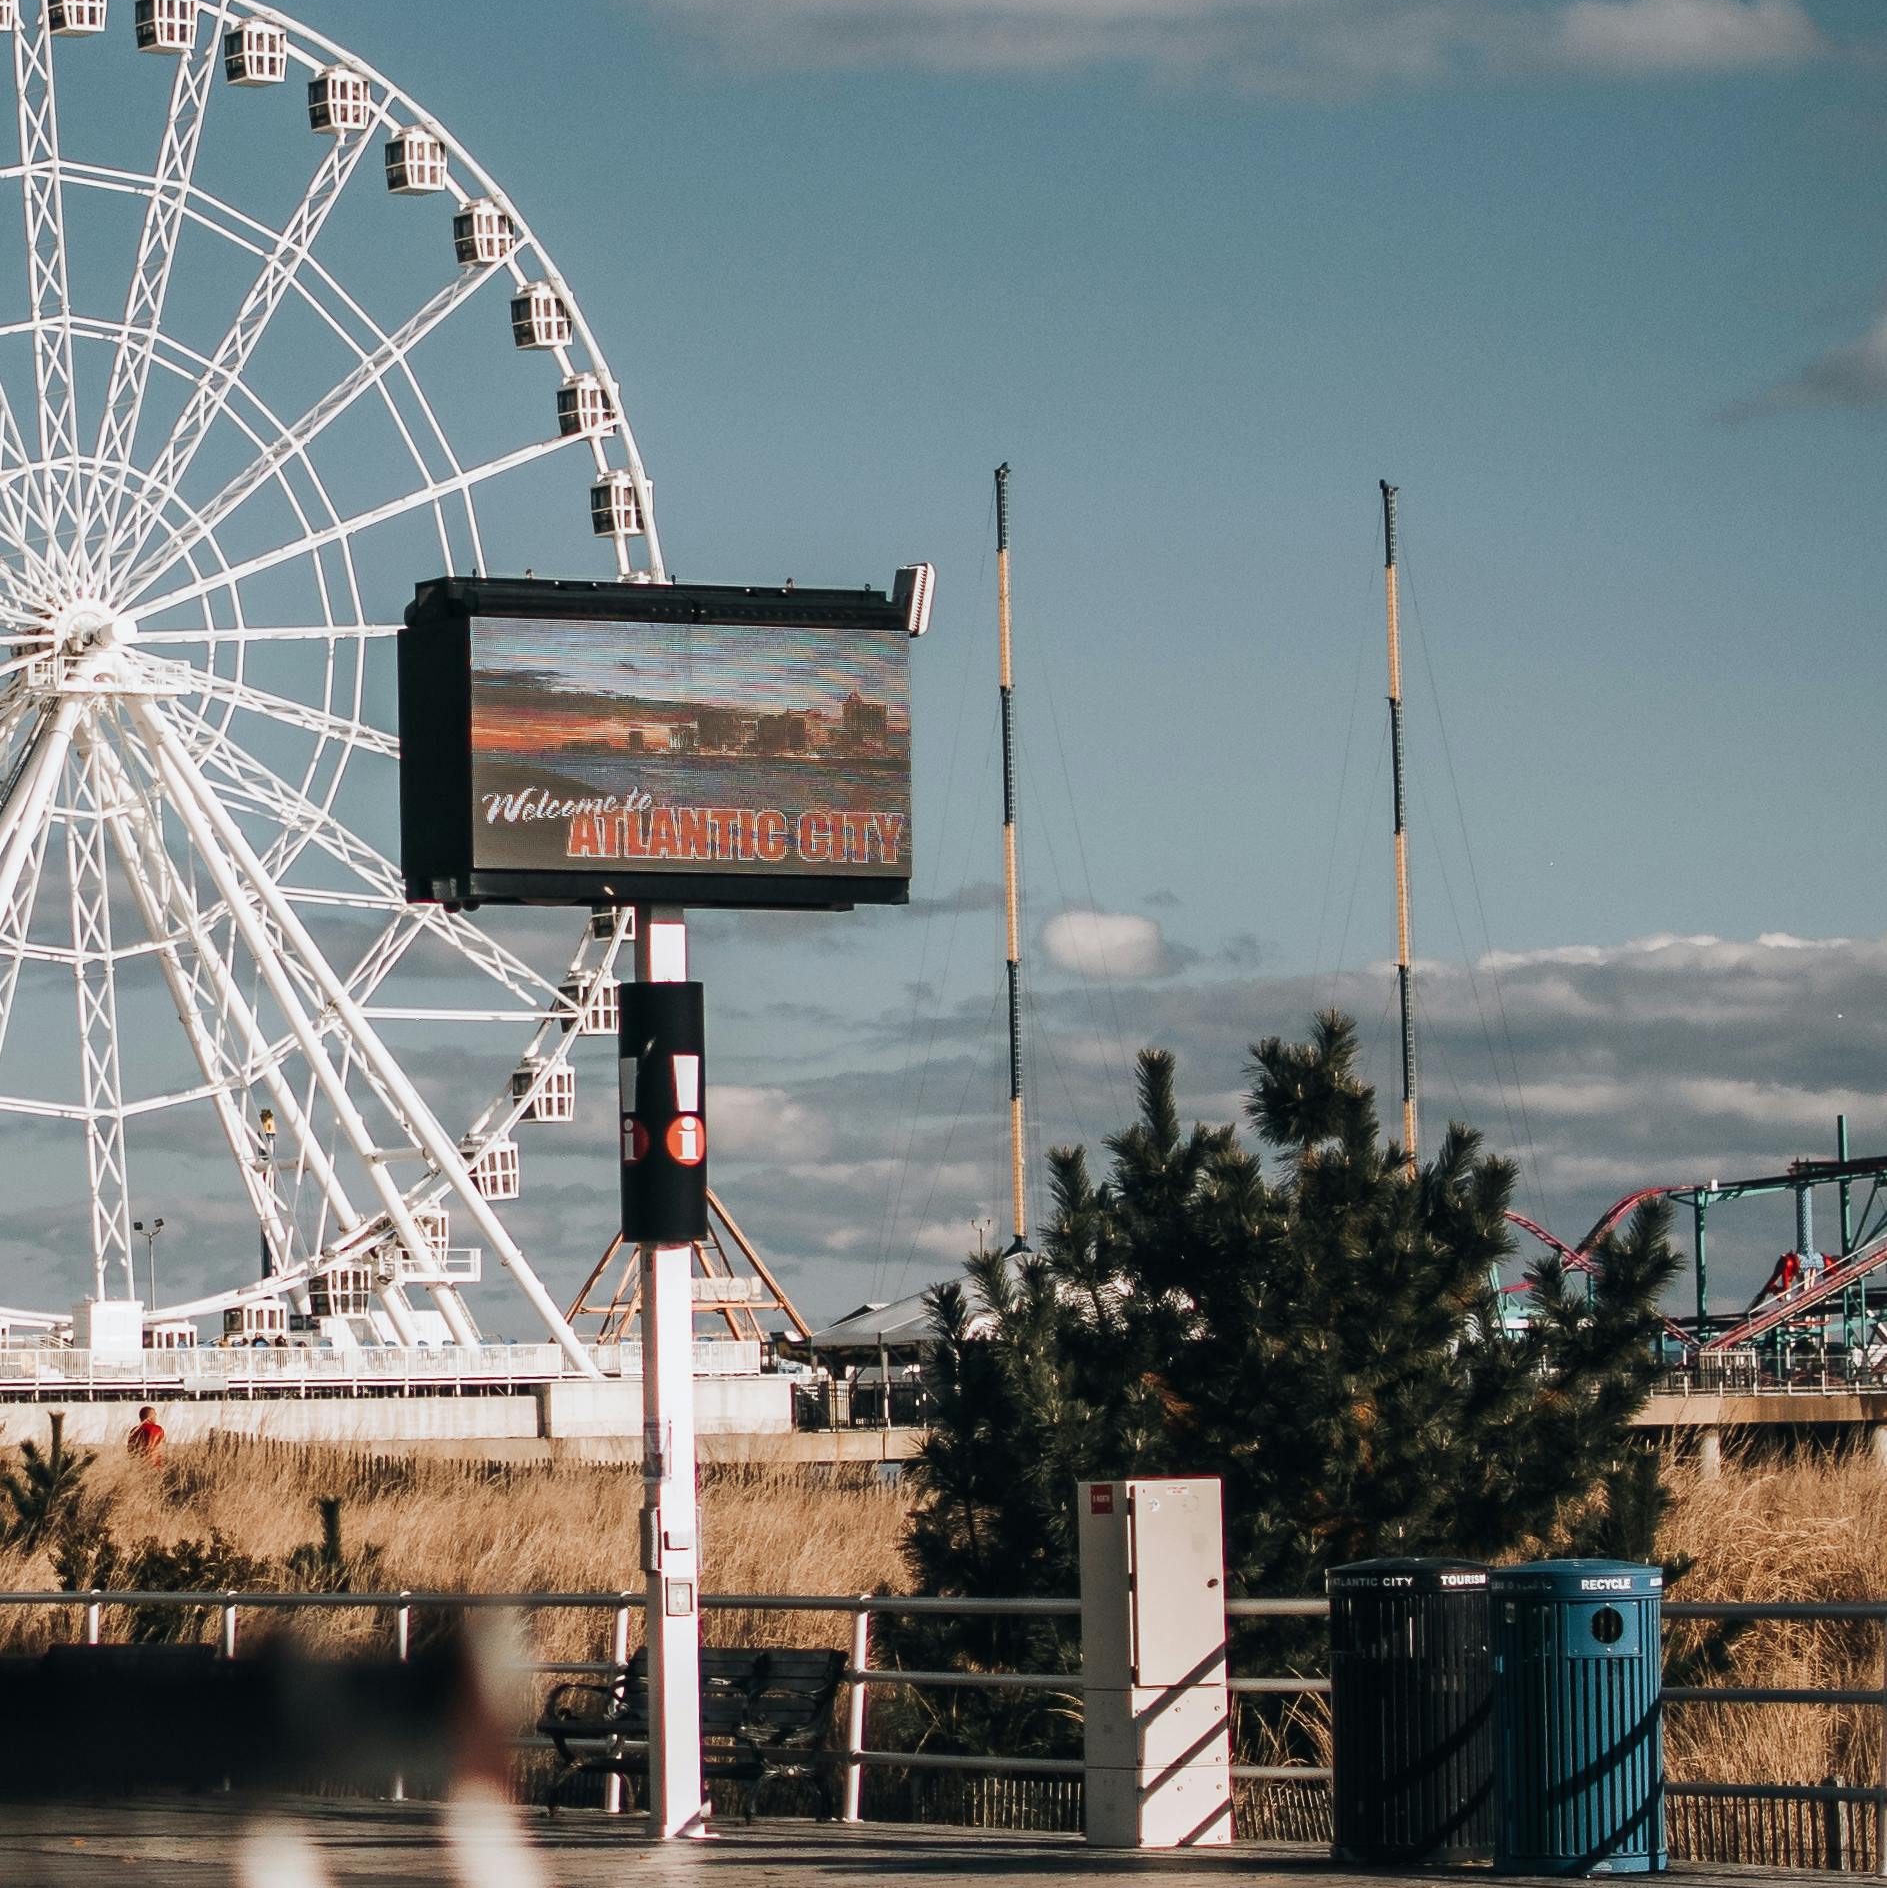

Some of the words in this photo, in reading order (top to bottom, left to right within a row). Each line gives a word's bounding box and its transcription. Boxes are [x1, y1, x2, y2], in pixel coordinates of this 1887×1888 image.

[482, 785, 618, 824] Welcome
[626, 785, 654, 812] to
[567, 807, 787, 861] ATLANTIC
[798, 812, 905, 863] CITY
[1382, 1577, 1414, 1587] CITY
[1440, 1574, 1487, 1586] TOURISM
[1581, 1578, 1631, 1591] RECYCLE
